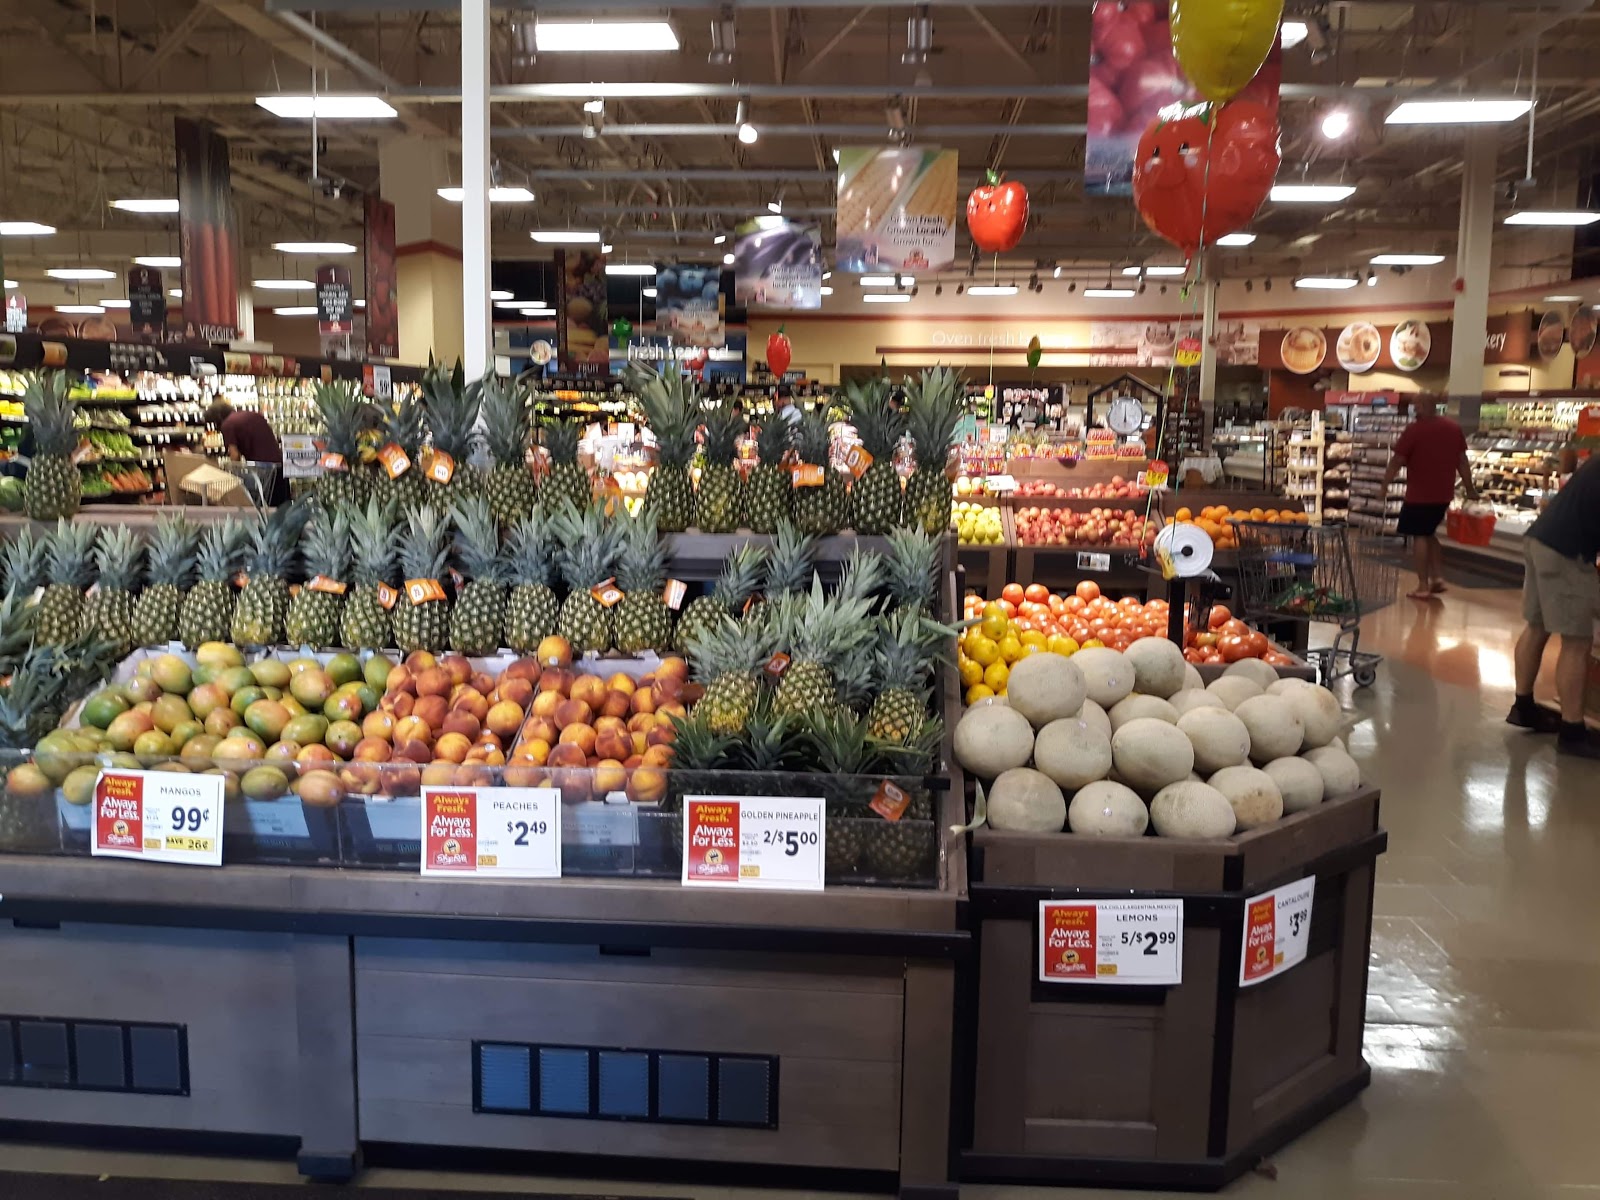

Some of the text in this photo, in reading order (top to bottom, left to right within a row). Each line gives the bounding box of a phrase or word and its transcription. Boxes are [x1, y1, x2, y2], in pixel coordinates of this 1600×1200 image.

[199, 323, 236, 341] VEGGIES
[932, 332, 973, 345] Oven
[978, 331, 1015, 345] fresh
[1486, 331, 1507, 351] kery
[104, 777, 137, 788] Always
[107, 786, 133, 796] Fresh.
[160, 786, 201, 796] MANGOS
[103, 797, 138, 810] Always
[433, 795, 470, 806] Always
[493, 801, 539, 811] PEACHES
[101, 807, 117, 818] For
[119, 808, 140, 821] Less.
[436, 804, 466, 814] Fresh.
[696, 805, 732, 815] Always
[171, 806, 210, 831] 99¢
[699, 813, 729, 823] Fresh.
[741, 810, 818, 821] GOLDEN PINEAPPLE
[433, 815, 471, 828] Always
[431, 825, 473, 838] For Less.
[695, 825, 733, 838] Always
[693, 835, 711, 846] For
[711, 835, 736, 848] Less.
[1052, 909, 1089, 919] Always
[1116, 914, 1158, 922] LEMONS
[1055, 917, 1085, 926] Fresh.
[1051, 928, 1089, 938] Always
[1049, 937, 1067, 948] For
[1068, 938, 1093, 949] Less.
